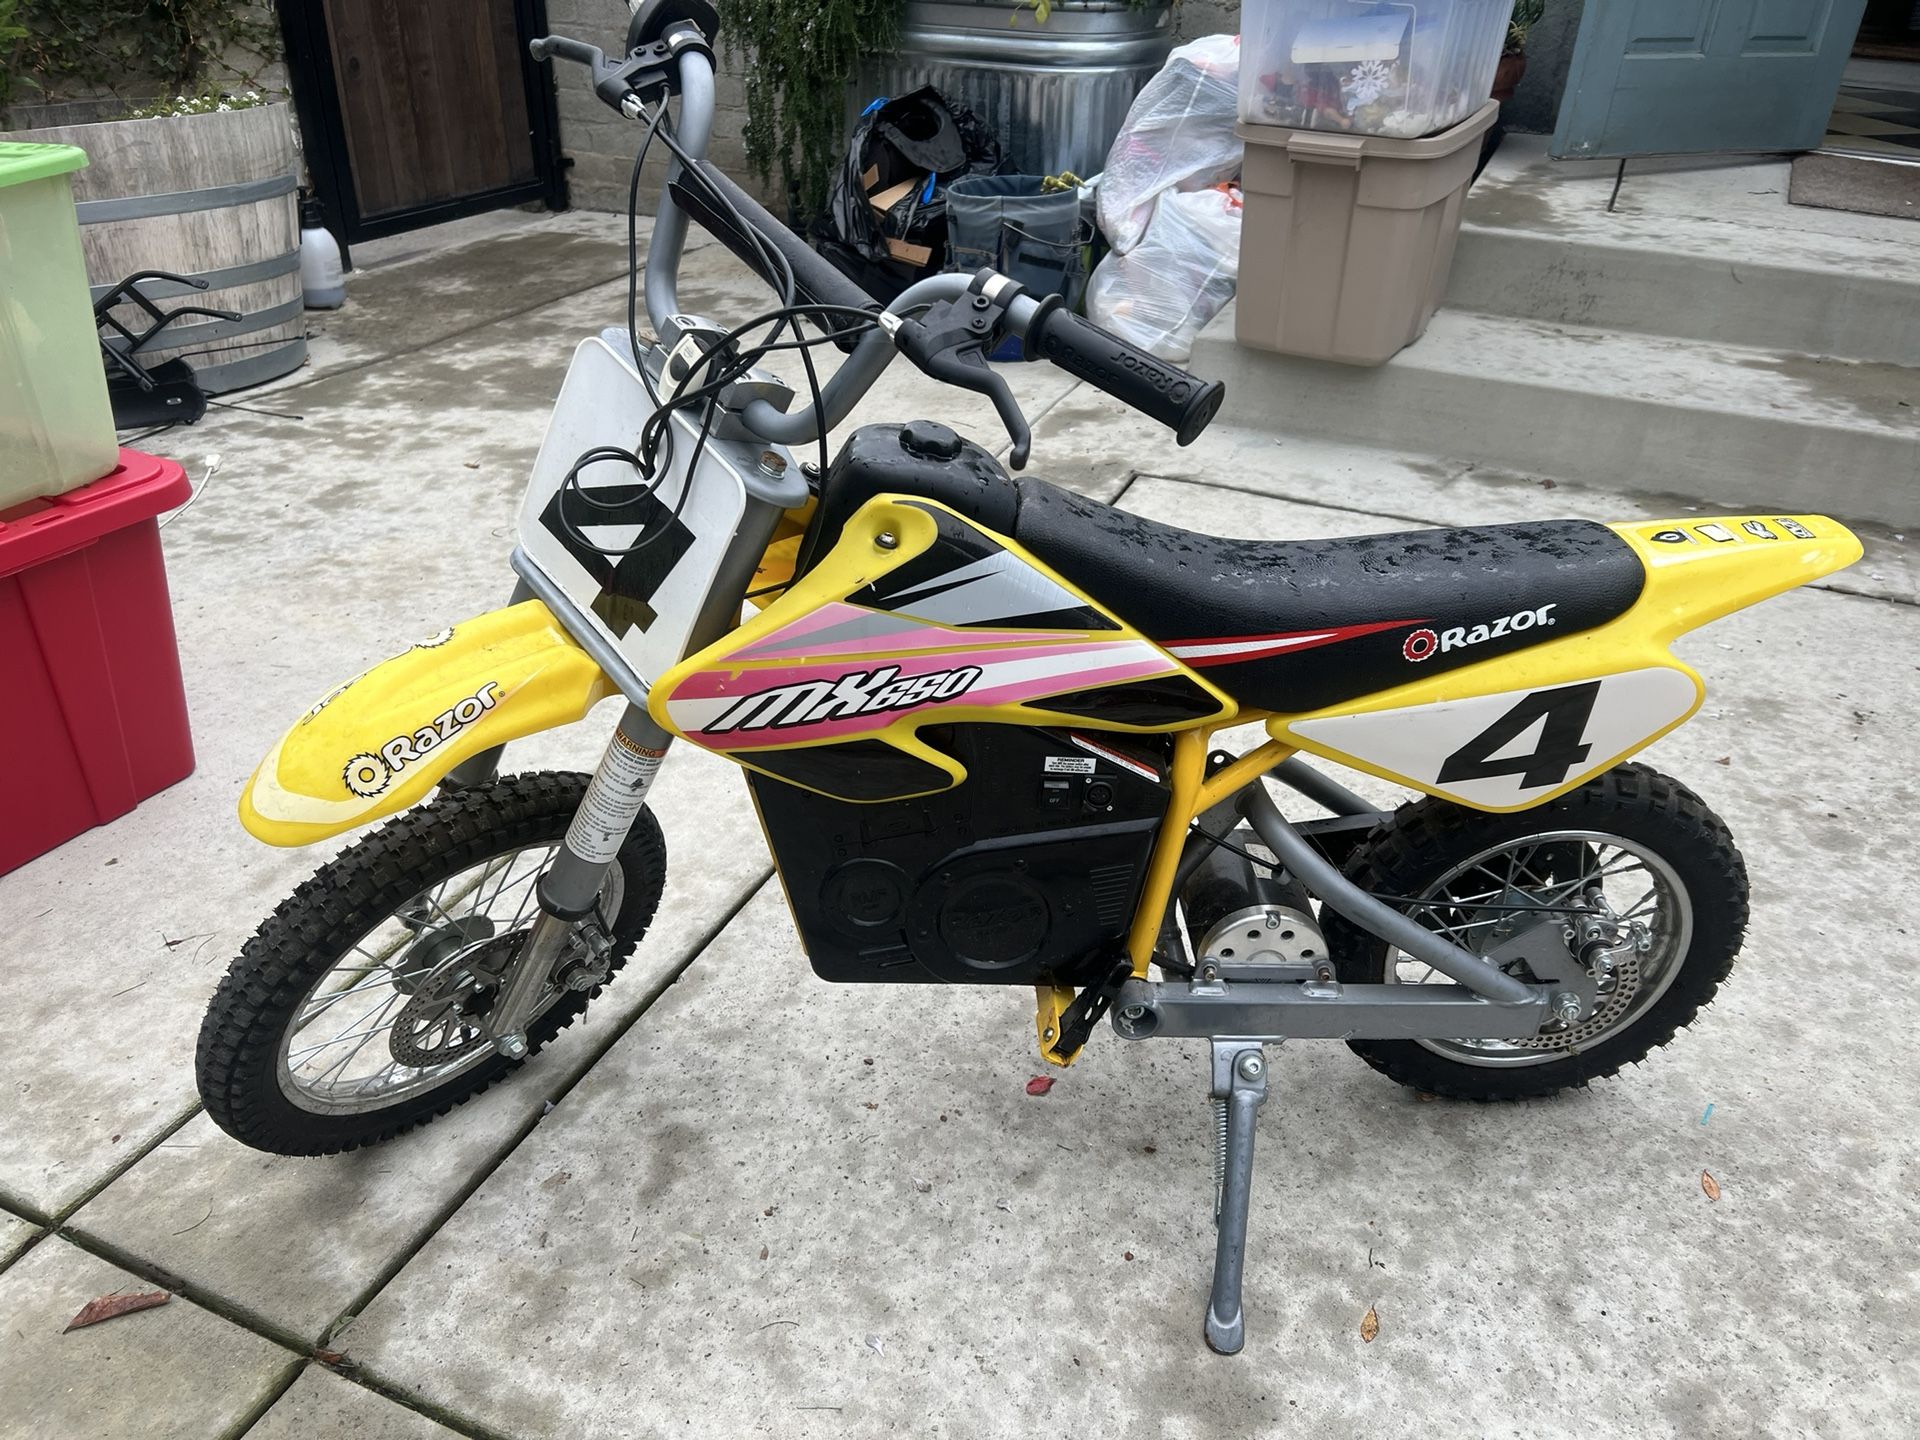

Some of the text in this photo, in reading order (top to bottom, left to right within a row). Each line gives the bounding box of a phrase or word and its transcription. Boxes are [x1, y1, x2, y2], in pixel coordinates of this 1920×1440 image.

[1441, 603, 1557, 652] Razor
[381, 681, 498, 773] Razor
[701, 665, 983, 734] MX650
[616, 730, 656, 757] WARNING
[1436, 680, 1602, 790] 4
